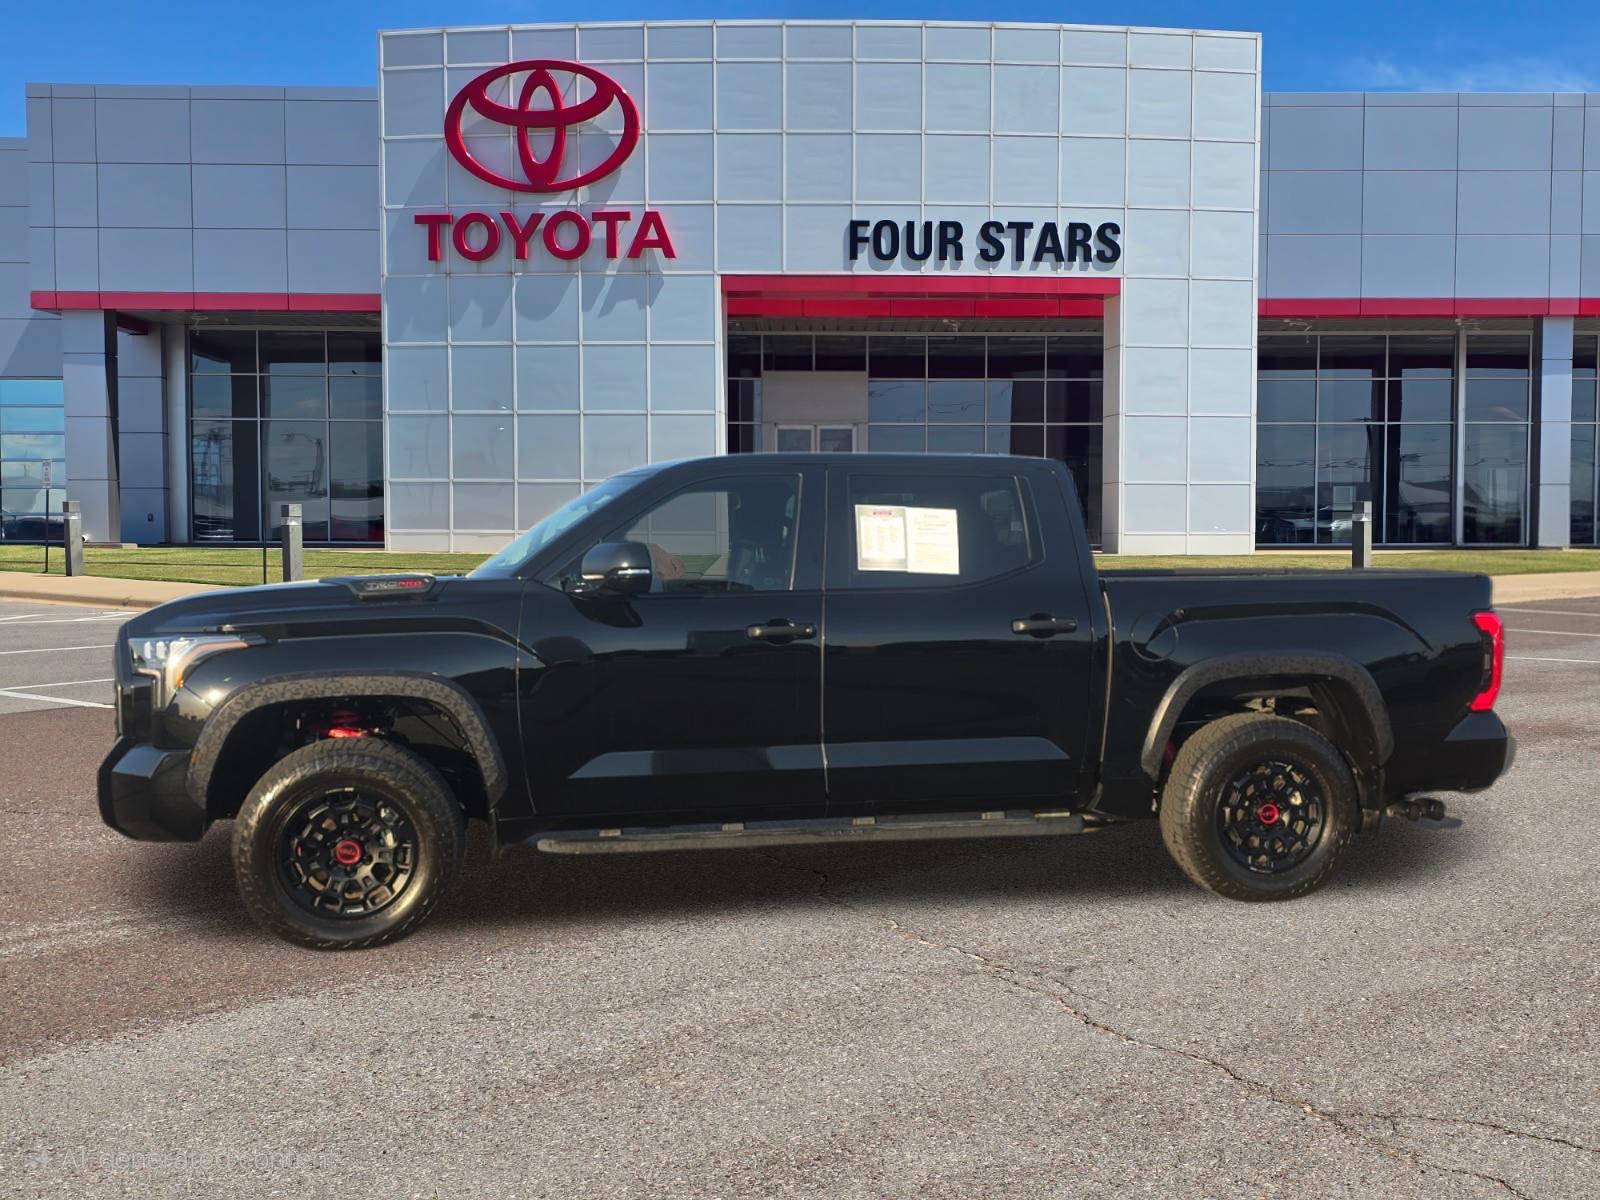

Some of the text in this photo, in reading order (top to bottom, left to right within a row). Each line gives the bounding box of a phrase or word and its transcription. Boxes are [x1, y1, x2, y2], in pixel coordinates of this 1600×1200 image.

[414, 210, 677, 261] TOYOTA
[849, 220, 1121, 263] FOUR STARS
